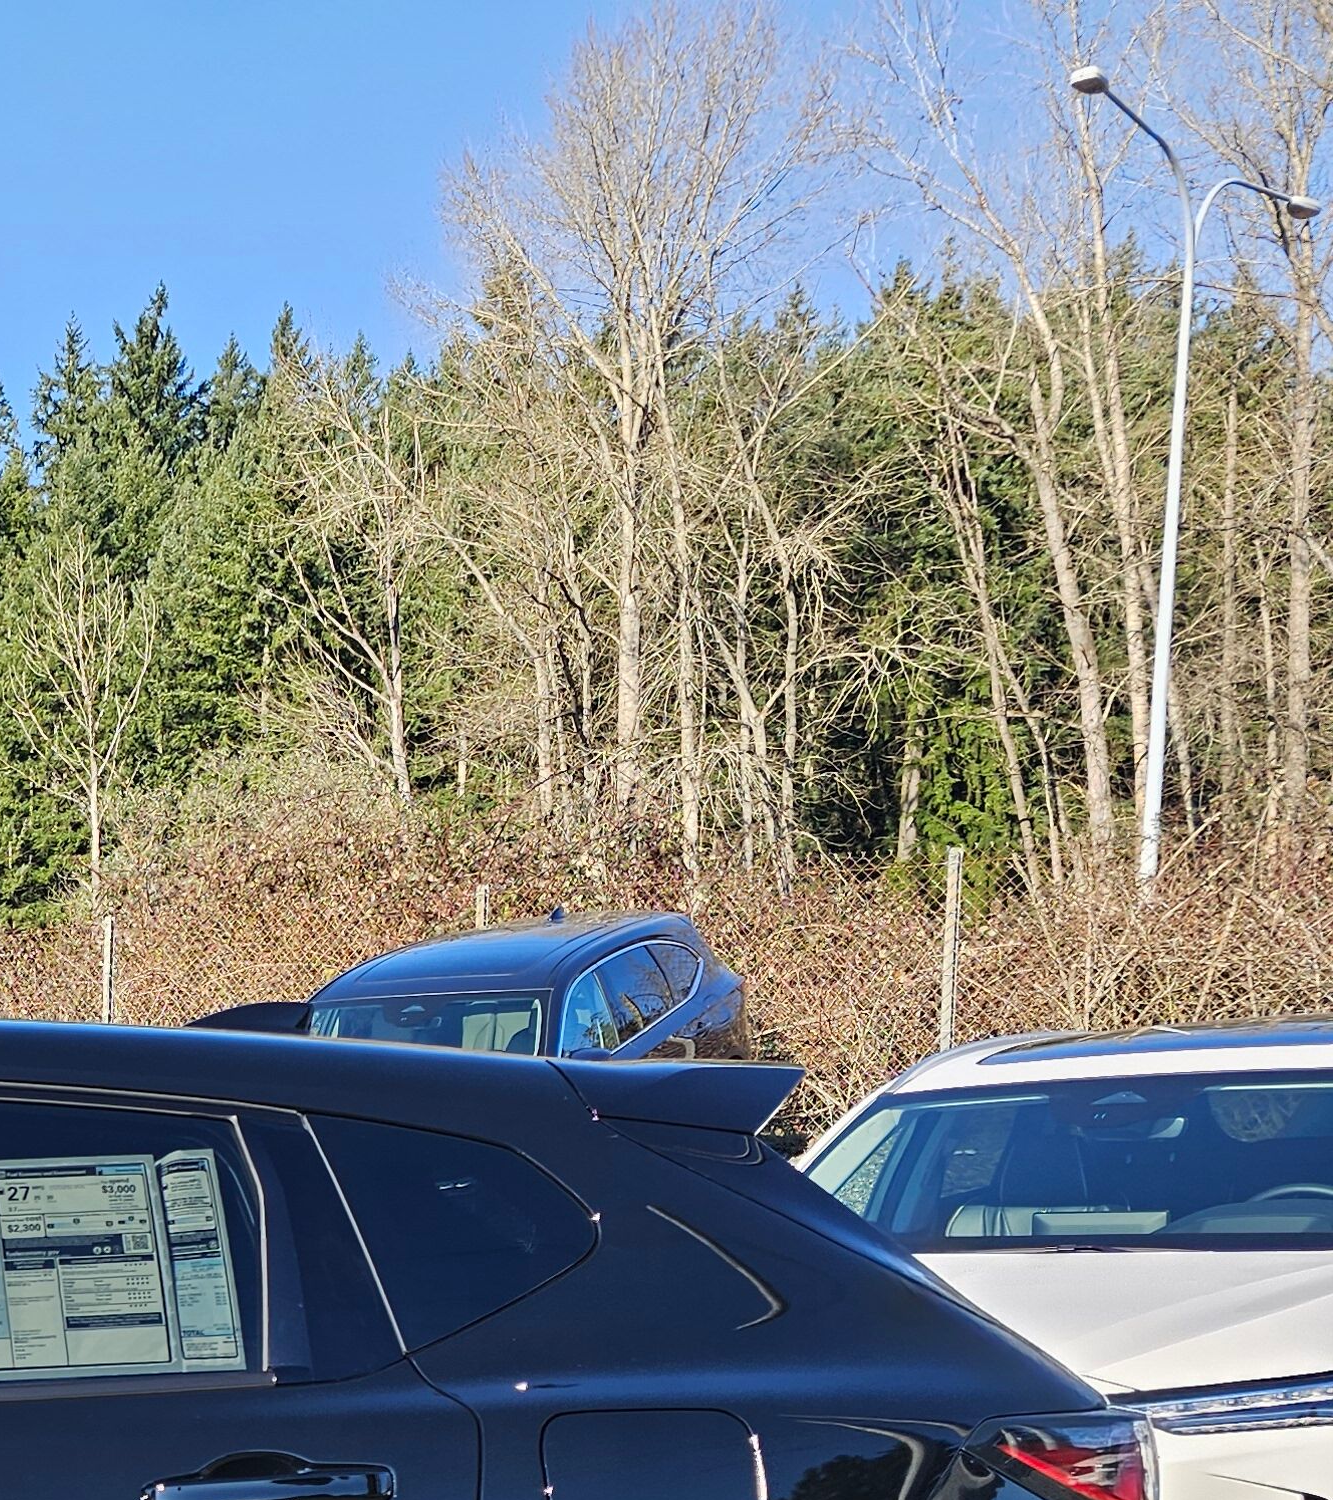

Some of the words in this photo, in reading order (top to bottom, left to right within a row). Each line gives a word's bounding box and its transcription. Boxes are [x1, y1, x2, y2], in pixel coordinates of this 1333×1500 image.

[7, 1186, 30, 1201] 27
[101, 1184, 136, 1196] $3,000
[7, 1223, 41, 1233] $2,300
